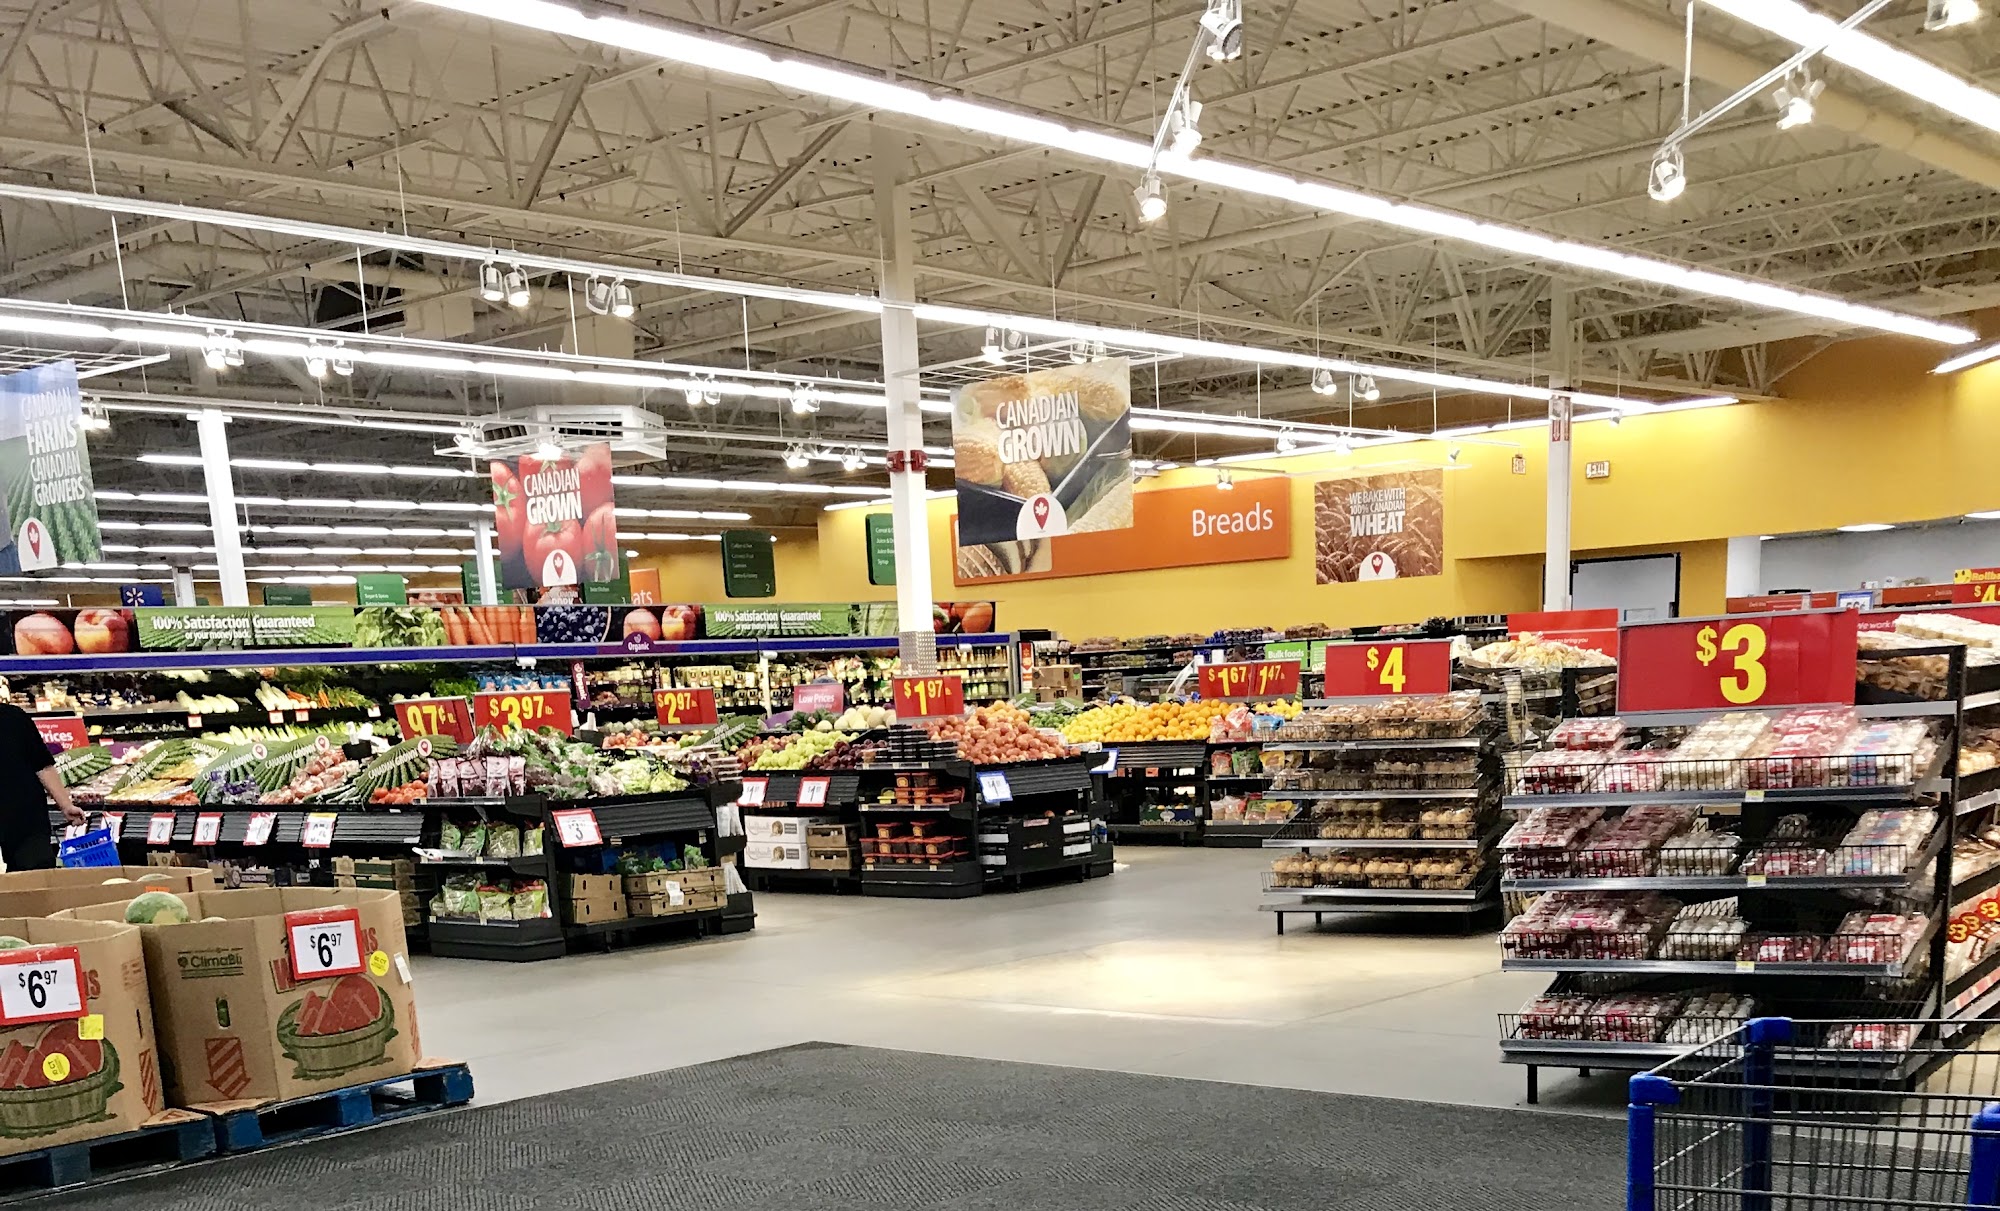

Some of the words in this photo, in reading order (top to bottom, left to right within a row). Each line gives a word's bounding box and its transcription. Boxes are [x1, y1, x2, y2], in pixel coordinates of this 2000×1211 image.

[21, 386, 73, 421] CANADIAN
[996, 390, 1080, 430] CANADIAN
[25, 414, 78, 456] FARMS
[998, 419, 1081, 465] GROWN
[30, 450, 82, 482] CANADIAN
[34, 475, 86, 507] GROWERS
[523, 467, 581, 497] CANADIAN
[526, 490, 583, 525] GROWN
[1349, 491, 1362, 505] WE
[1363, 489, 1383, 504] BAKE
[1384, 487, 1406, 501] WITH
[1350, 503, 1369, 516] 100%
[1370, 499, 1406, 513] CANADIAN
[1192, 501, 1274, 537] Breads
[1350, 510, 1406, 538] WHEAT
[632, 589, 654, 606] ats
[765, 583, 771, 593] 2
[151, 614, 182, 630] 100%
[184, 613, 249, 630] Satisfaction
[253, 613, 316, 628] Guaranteed
[714, 610, 734, 622] 100%
[734, 610, 778, 622] Satisfaction
[780, 609, 822, 621] Guaranteed
[210, 630, 233, 641] money
[627, 641, 650, 653] Organic
[1577, 637, 1589, 645] you
[1268, 650, 1284, 659] Bulk
[1284, 649, 1304, 659] foods
[1696, 623, 1767, 704] $3
[1366, 646, 1406, 693] $4
[575, 672, 588, 701] Organic
[798, 693, 814, 704] Low
[814, 693, 835, 704] Prices
[230, 752, 254, 767] GROWN
[264, 751, 293, 770] CANADIAN
[293, 743, 316, 759] GROWN
[368, 757, 395, 780] CANADIAN
[395, 747, 419, 765] GROWN
[1949, 923, 1968, 942] $3
